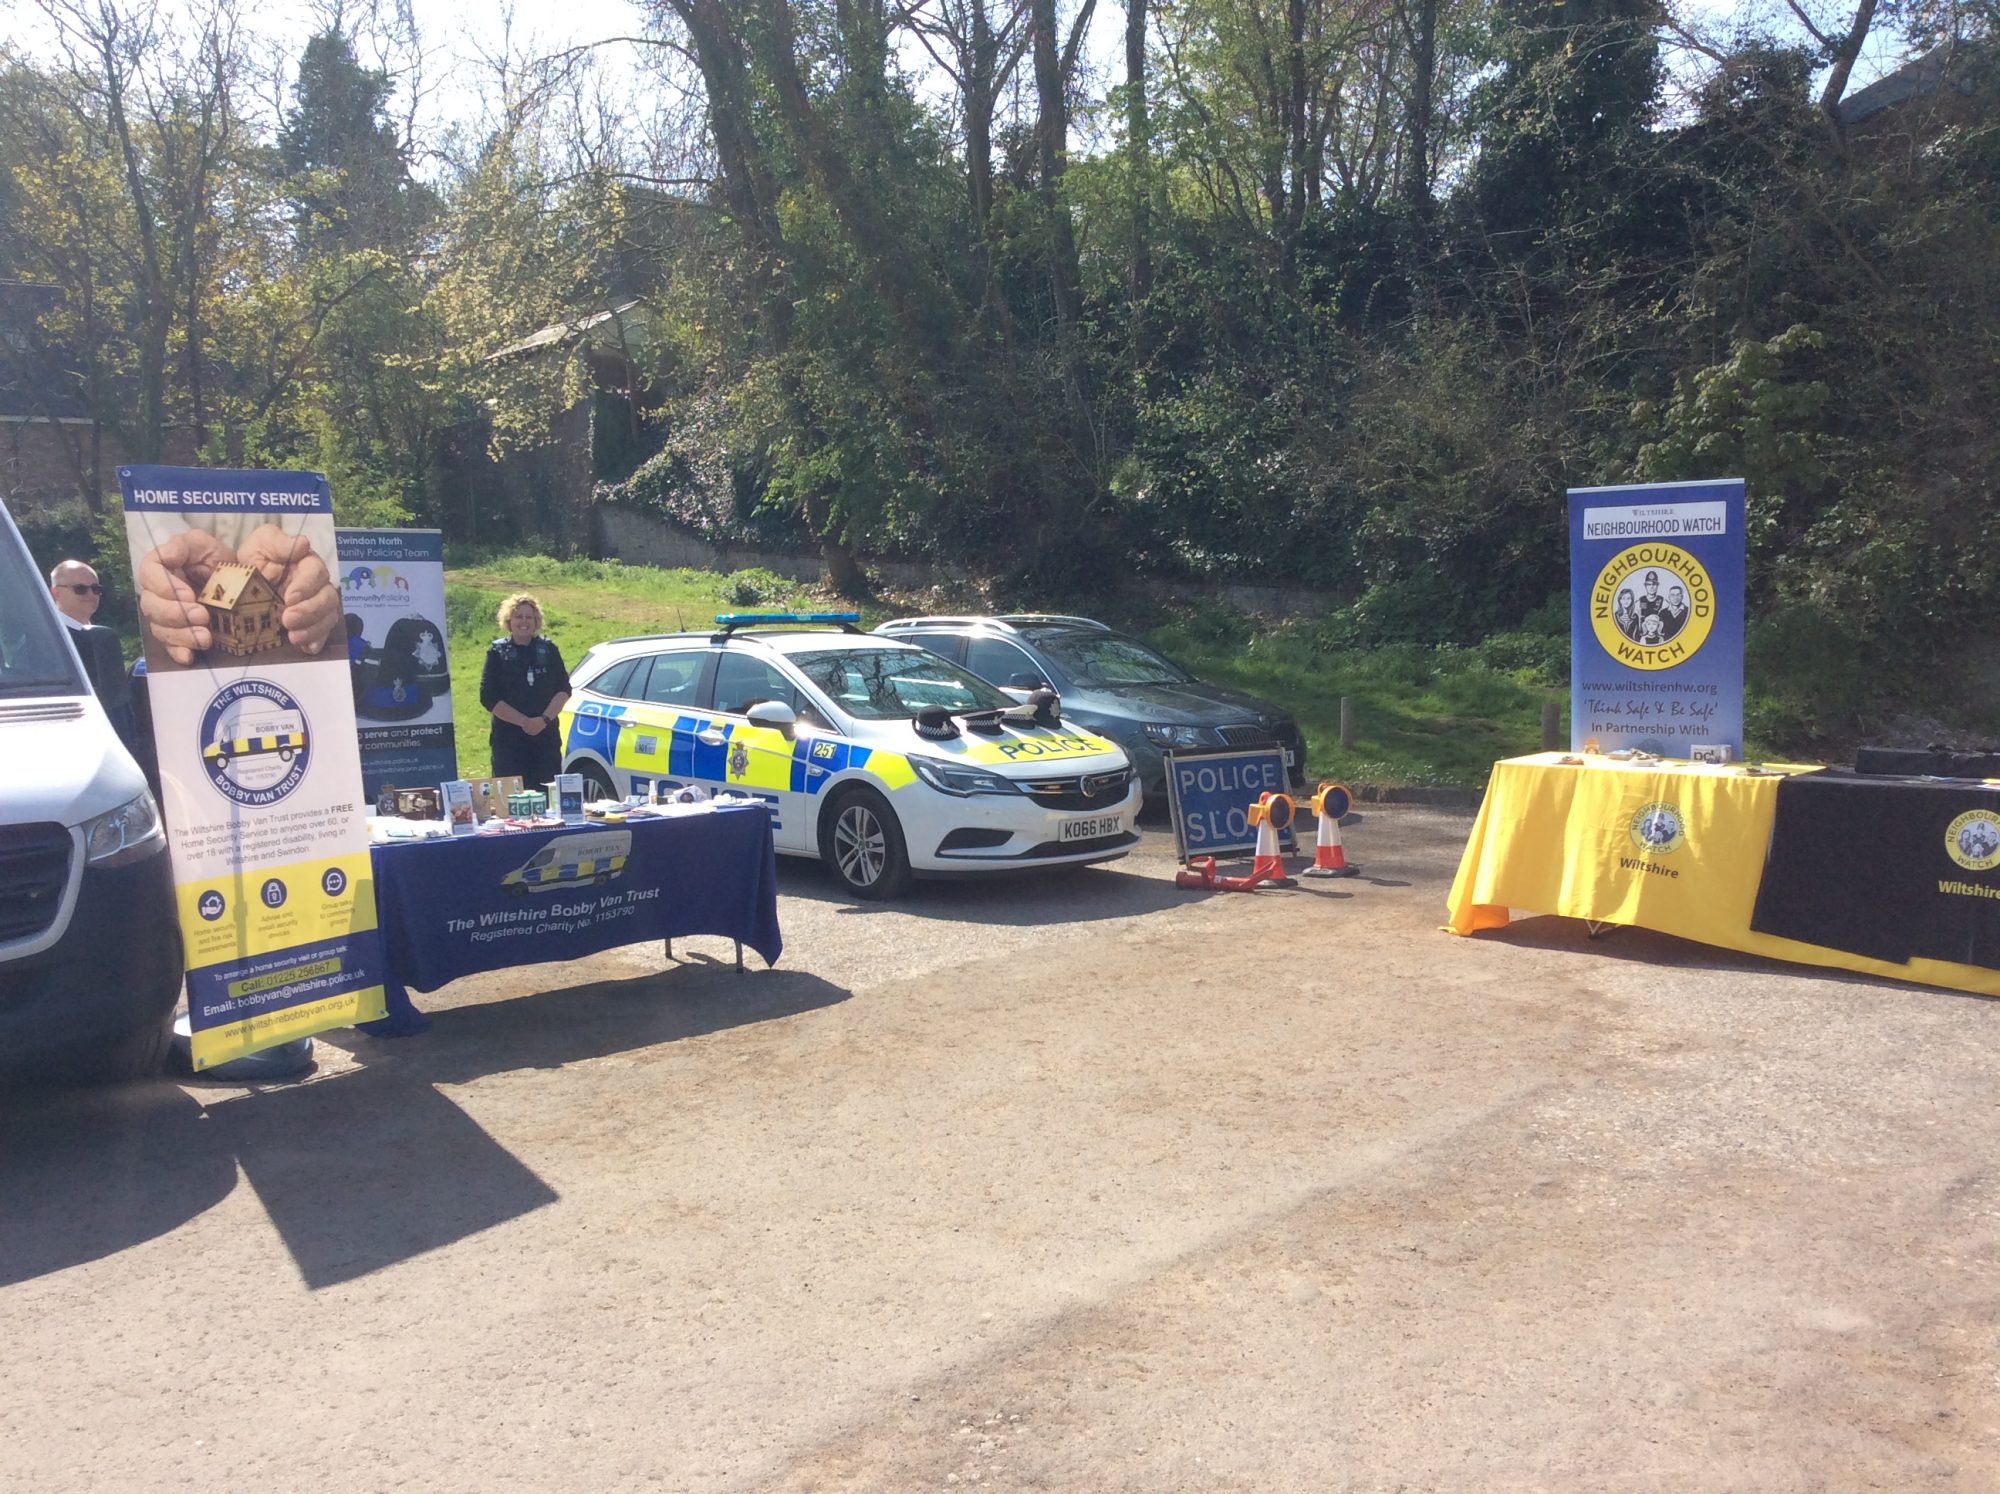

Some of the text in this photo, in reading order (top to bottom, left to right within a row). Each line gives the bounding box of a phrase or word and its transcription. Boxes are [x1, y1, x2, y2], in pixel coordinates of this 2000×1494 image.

[133, 489, 321, 507] HOME SECURITY SERVICE
[1587, 517, 1721, 537] NEIGHBOURHOOD WATCH
[337, 536, 403, 545] Swindon North
[367, 548, 402, 559] Policing
[404, 548, 430, 557] Team
[1596, 548, 1709, 619] NEIGHBOURHOOD
[343, 594, 410, 603] ommunityPolicing
[1617, 642, 1685, 665] WATCH
[213, 683, 289, 710] THE WILTSHIRE
[1582, 681, 1718, 696] www.wiltshirenhw.org
[1626, 700, 1650, 720] Safe
[1671, 701, 1686, 716] Be
[364, 730, 389, 739] serve
[390, 728, 408, 738] and
[410, 726, 442, 738] protect
[1591, 722, 1709, 737] In Partnership With
[364, 739, 421, 750] communities
[814, 743, 837, 758] 251
[998, 738, 1103, 760] POLICE
[215, 764, 304, 803] BOBBY VAN TRUST
[1180, 763, 1277, 795] POLICE
[174, 829, 189, 838] The
[190, 823, 224, 835] Wiltshire
[225, 819, 251, 831] Bobby
[254, 817, 268, 826] Van
[269, 813, 289, 823] Trust
[290, 807, 323, 822] provides
[330, 802, 354, 814] FREE
[1099, 816, 1120, 833] HBX
[1186, 806, 1250, 842] SLO
[181, 839, 205, 849] Home
[206, 832, 238, 846] Security
[239, 828, 269, 841] Service
[270, 827, 278, 835] to
[279, 824, 307, 836] anyone
[308, 820, 326, 829] over
[341, 815, 350, 824] or
[186, 851, 204, 862] over
[206, 848, 216, 857] 18
[218, 845, 233, 856] with
[242, 837, 281, 852] registered
[318, 828, 338, 840] living
[339, 827, 347, 836] in
[225, 854, 259, 867] Wiltshire
[260, 850, 277, 860] and
[1619, 857, 1679, 879] Wiltshire
[1957, 855, 1993, 868] WATCH
[1938, 880, 2000, 900] Wiltshire
[447, 887, 660, 933] The Wiltshire Bobby Van Trust
[470, 905, 635, 942] Registered Charity No. 1153790
[214, 973, 222, 981] To
[255, 962, 273, 974] home
[273, 956, 298, 969] security
[311, 951, 318, 959] or
[318, 947, 336, 959] group
[203, 968, 366, 1017] Email: bobbyvan@wiltshire.police.uk
[241, 978, 264, 992] Call:
[266, 972, 296, 987] 01225
[224, 996, 356, 1039] www.wiltshirebobbyvan.org.uk
